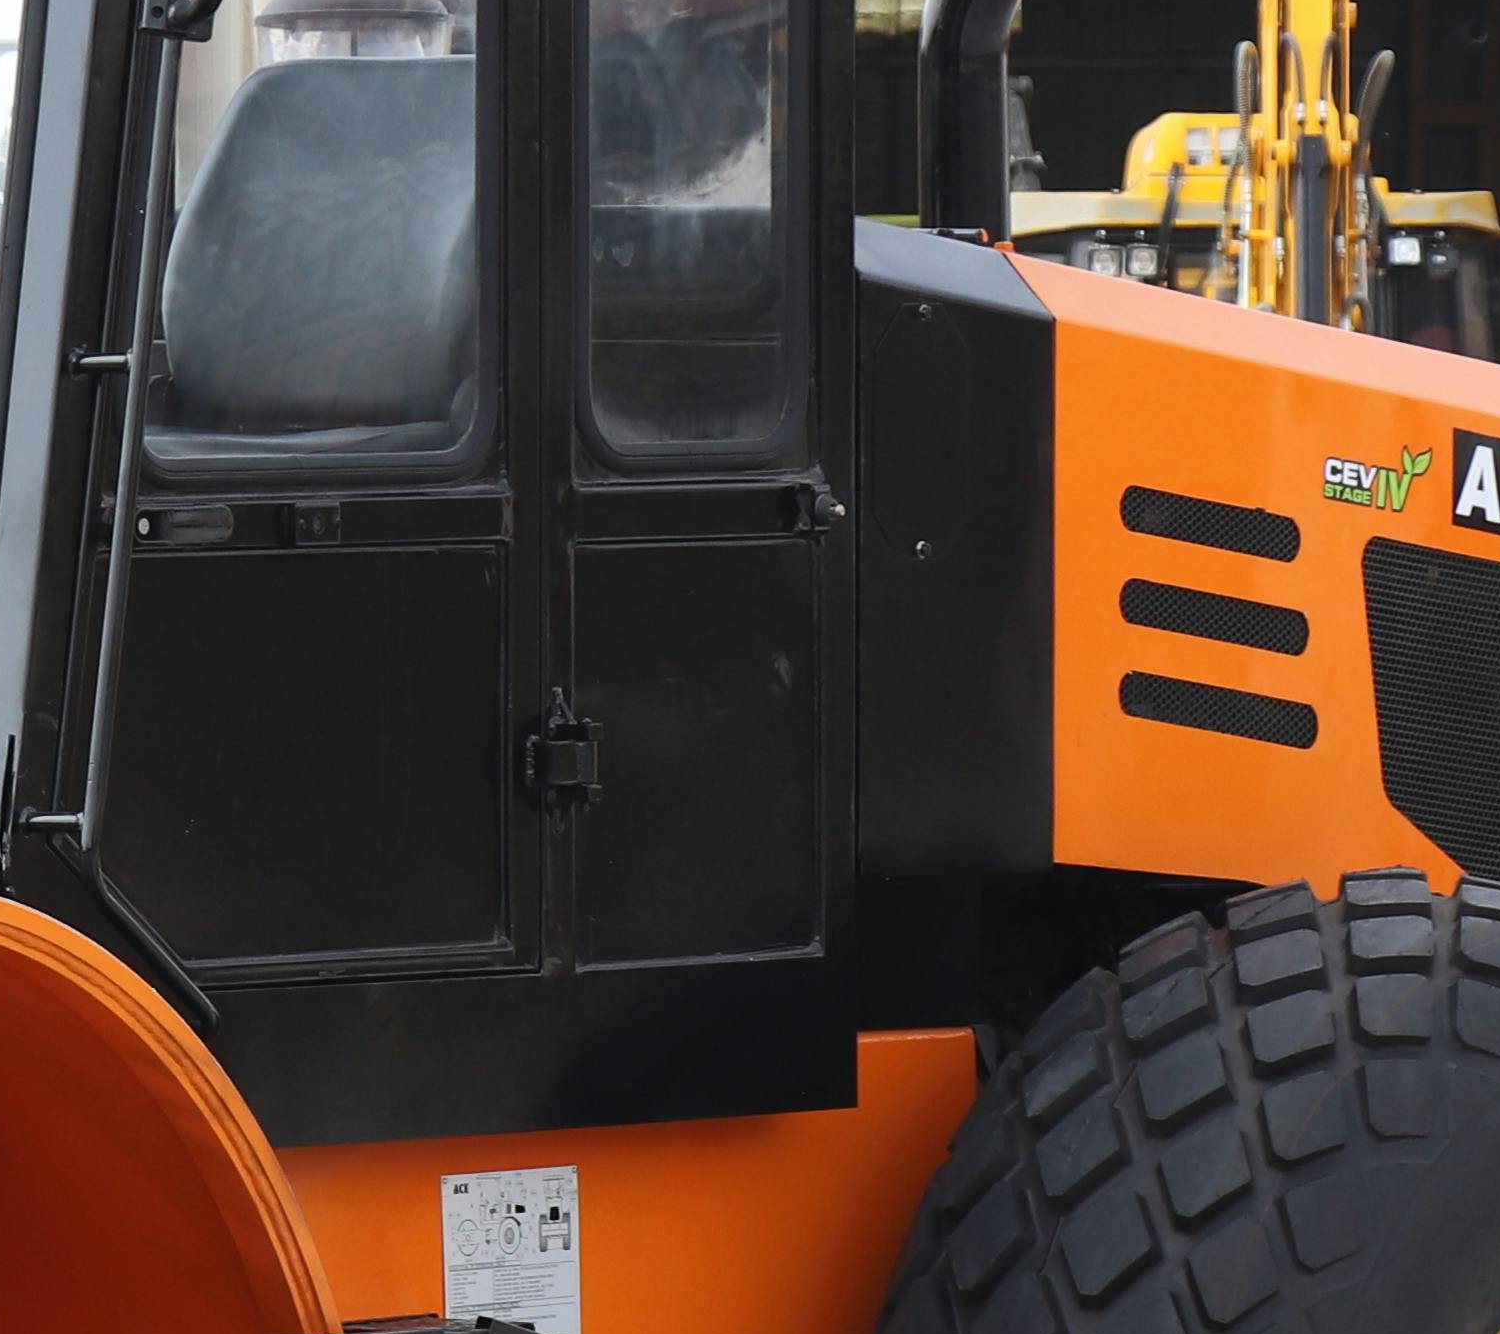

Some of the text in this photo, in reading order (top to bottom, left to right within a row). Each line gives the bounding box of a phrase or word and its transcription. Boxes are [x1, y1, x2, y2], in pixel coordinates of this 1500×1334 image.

[1324, 457, 1378, 489] CEV
[1323, 482, 1372, 505] STAGE
[1376, 468, 1414, 511] IV
